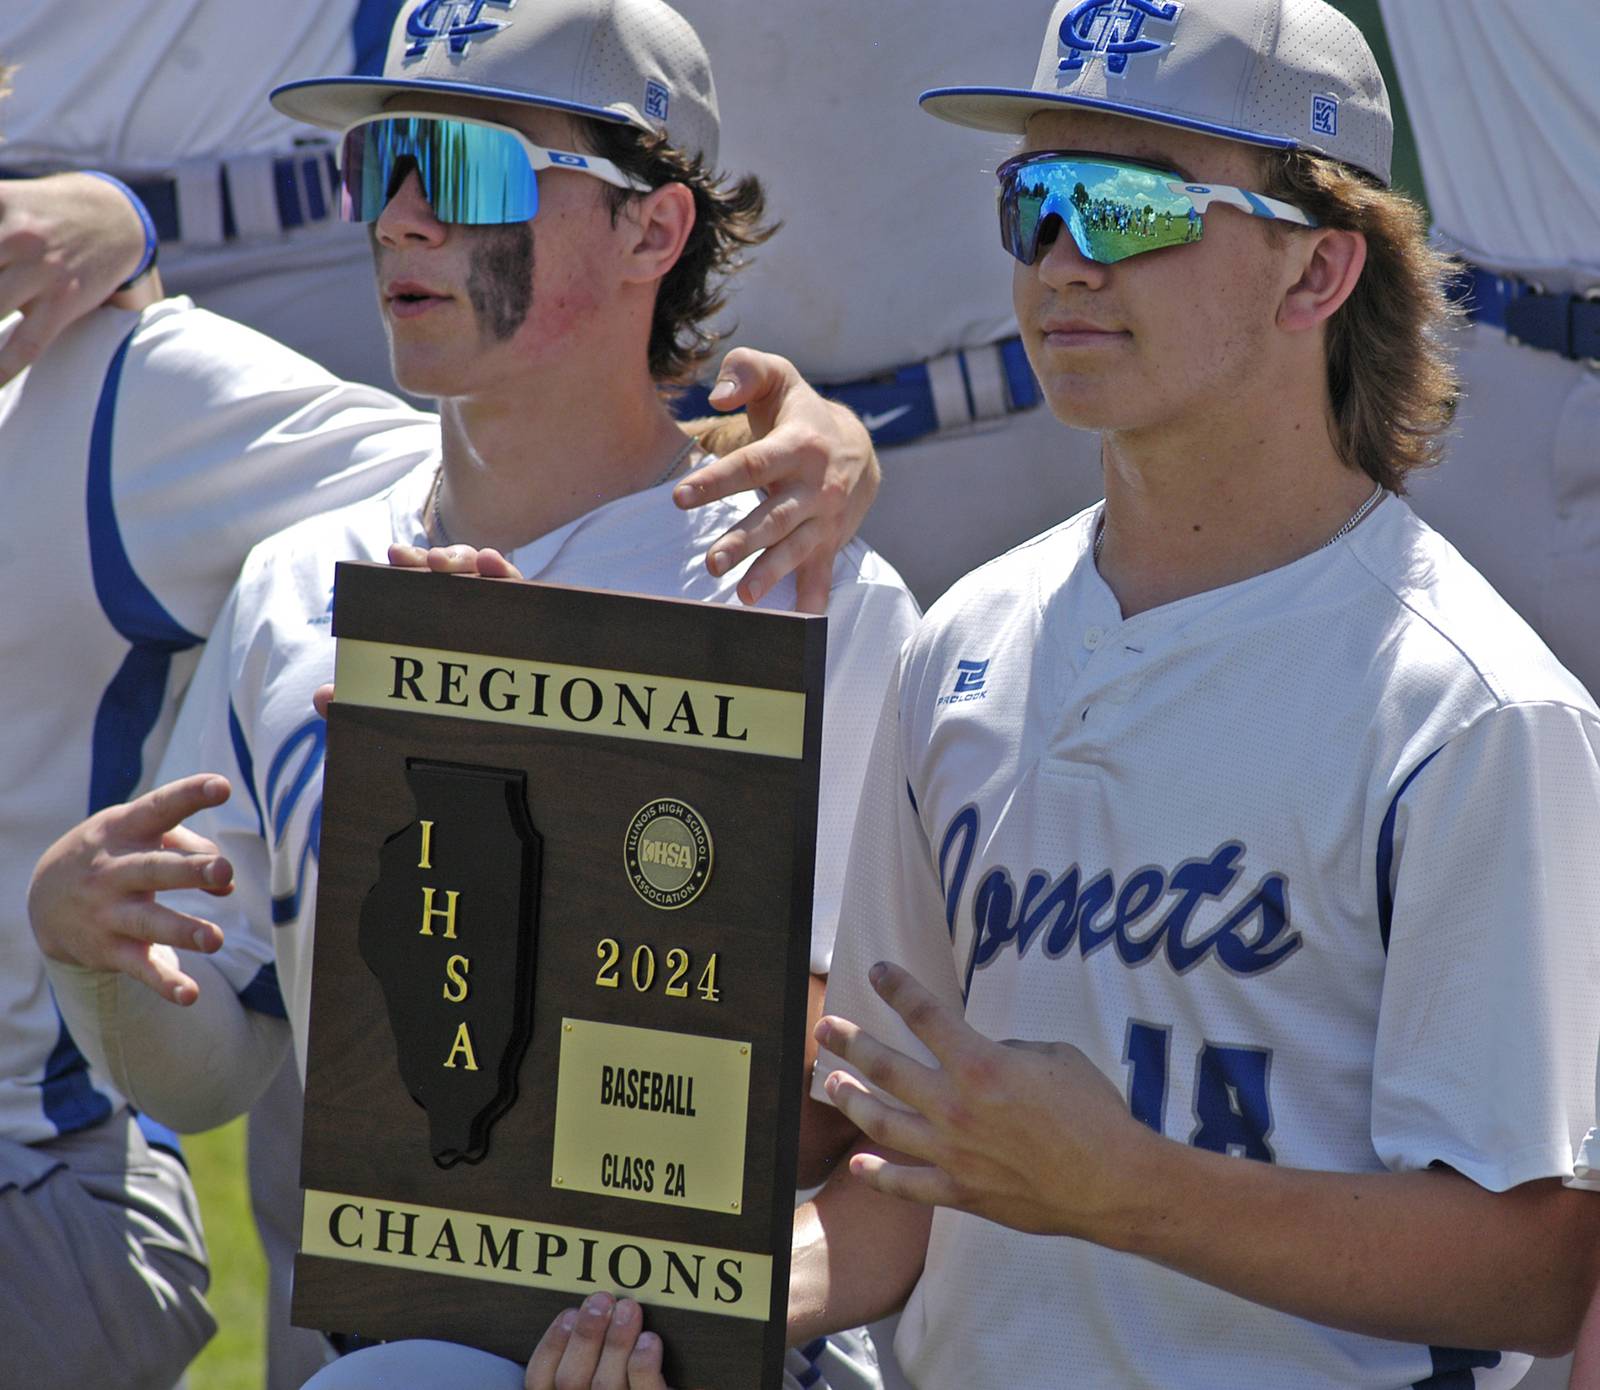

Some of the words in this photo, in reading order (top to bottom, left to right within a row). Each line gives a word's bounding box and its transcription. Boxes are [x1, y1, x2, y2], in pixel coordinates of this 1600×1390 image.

[387, 655, 749, 742] REGIONAL
[628, 806, 657, 851] ILLINOIS
[657, 803, 684, 817] HIGH
[685, 813, 707, 862] SCHOOL
[633, 873, 696, 904] ASSOCIATION
[595, 938, 720, 1002] 2024
[600, 1064, 696, 1117] BASEBALL
[601, 1152, 655, 1194] CLASS
[663, 1161, 686, 1198] 2A
[328, 1202, 744, 1304] CHAMPIONS
